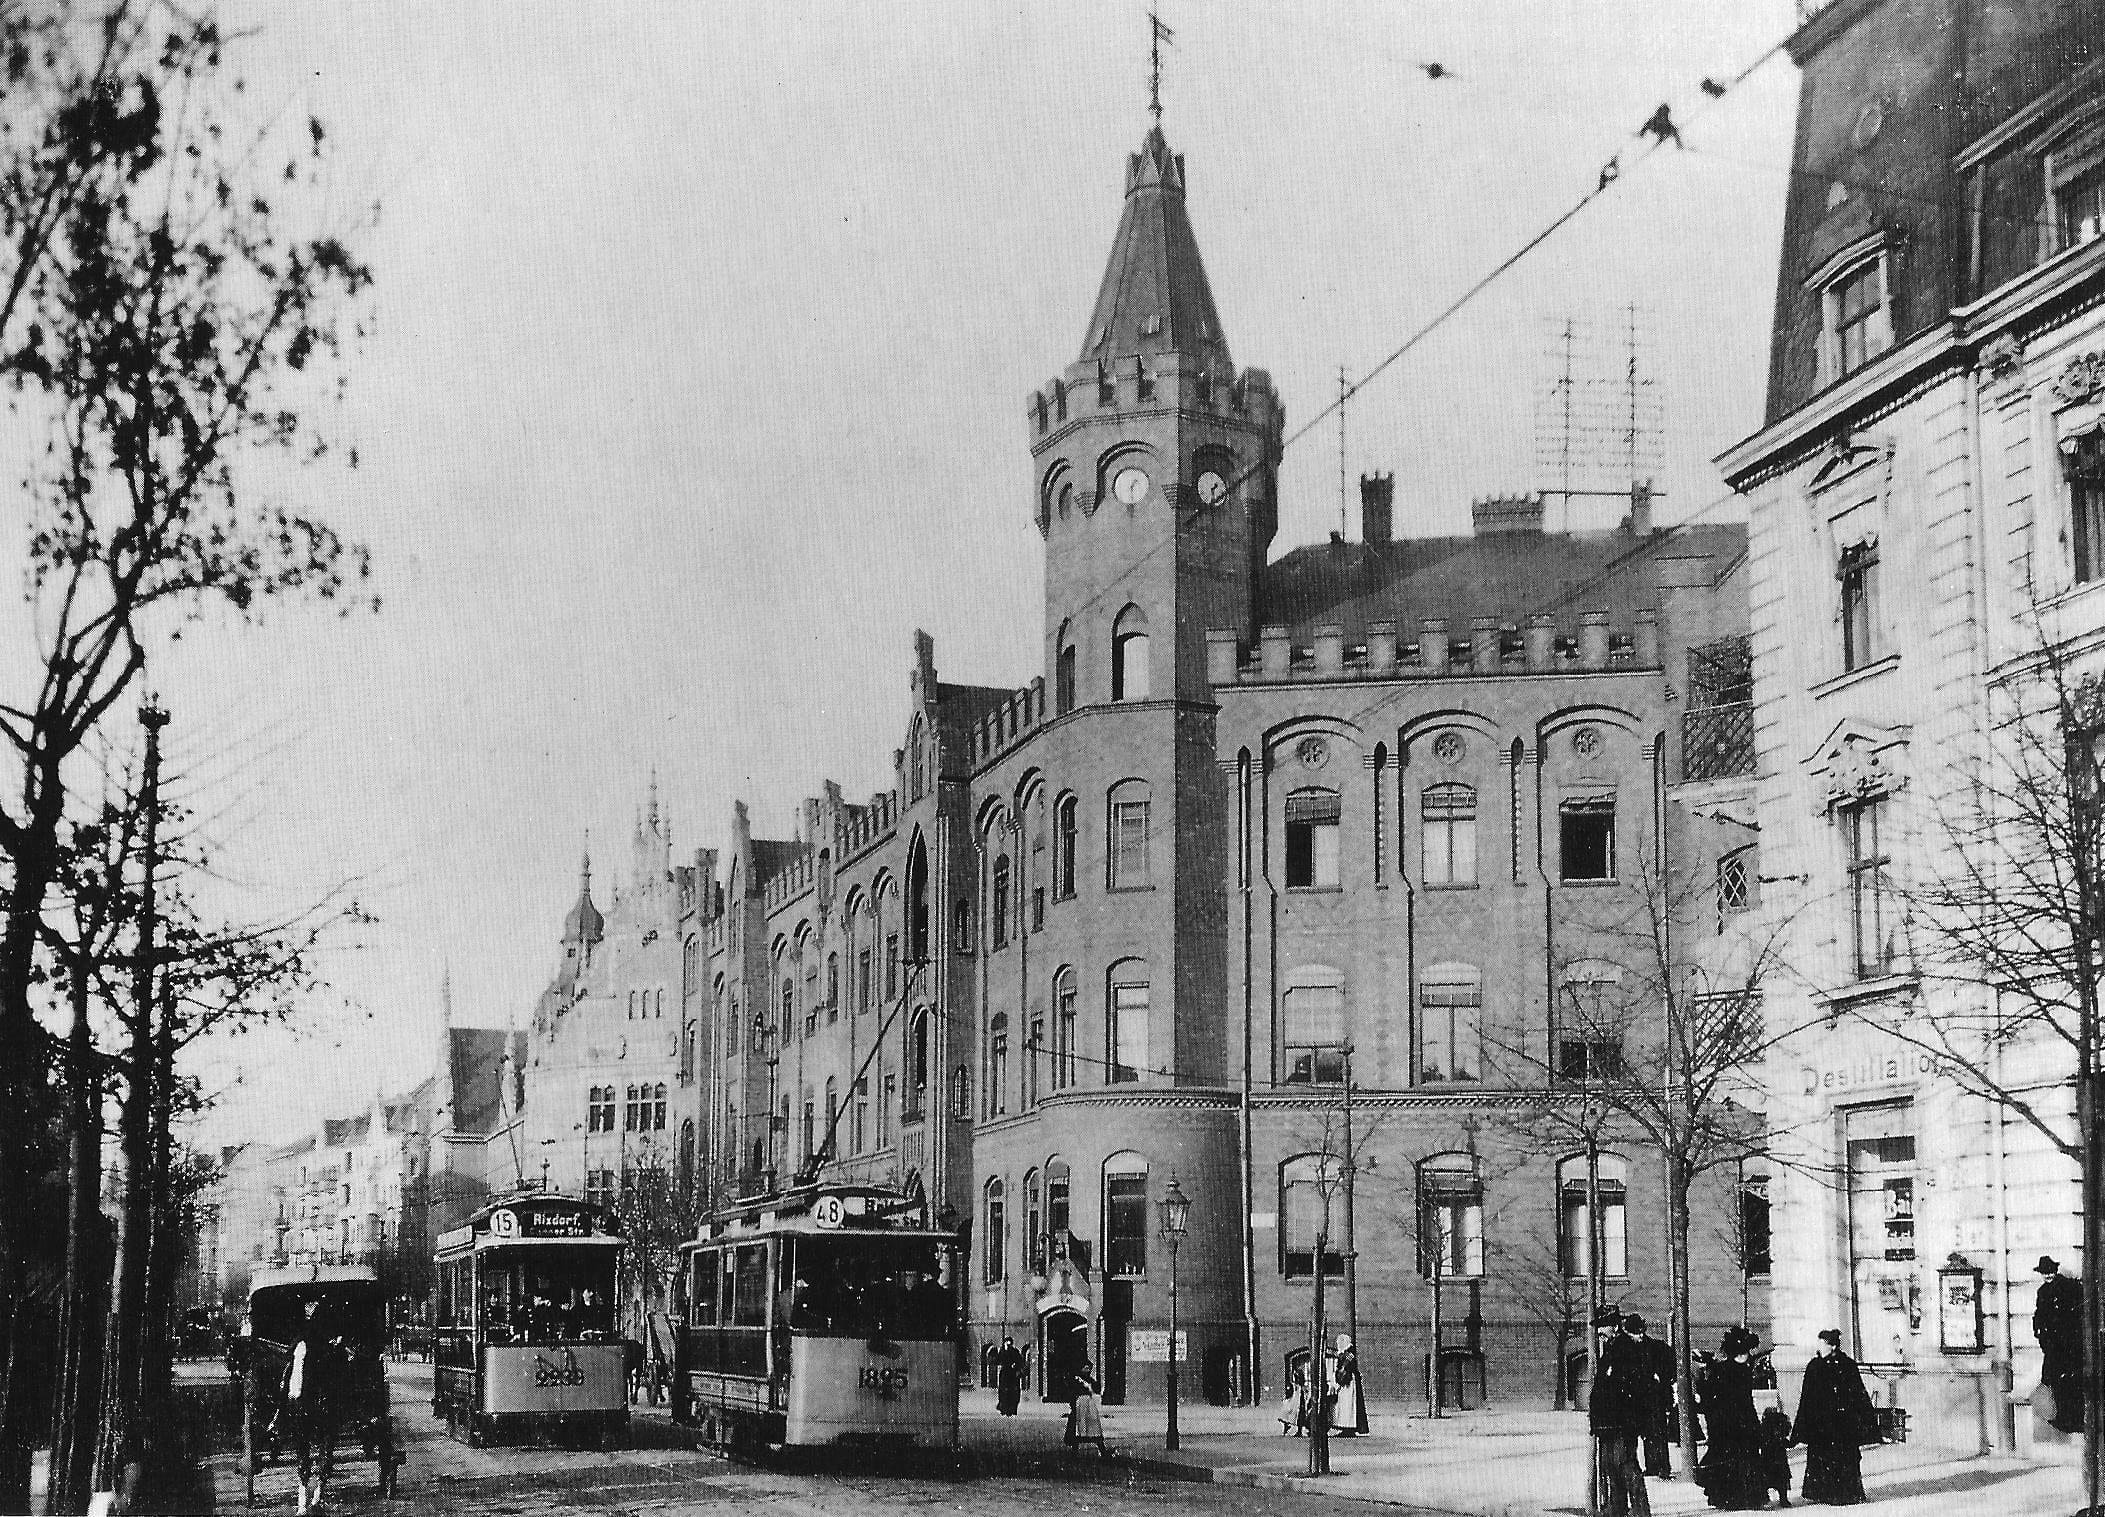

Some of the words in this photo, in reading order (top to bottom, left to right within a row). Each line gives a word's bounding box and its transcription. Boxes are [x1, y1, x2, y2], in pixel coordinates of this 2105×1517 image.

[495, 1213, 513, 1232] 15
[817, 1200, 839, 1223] 48
[859, 1366, 908, 1389] 1895
